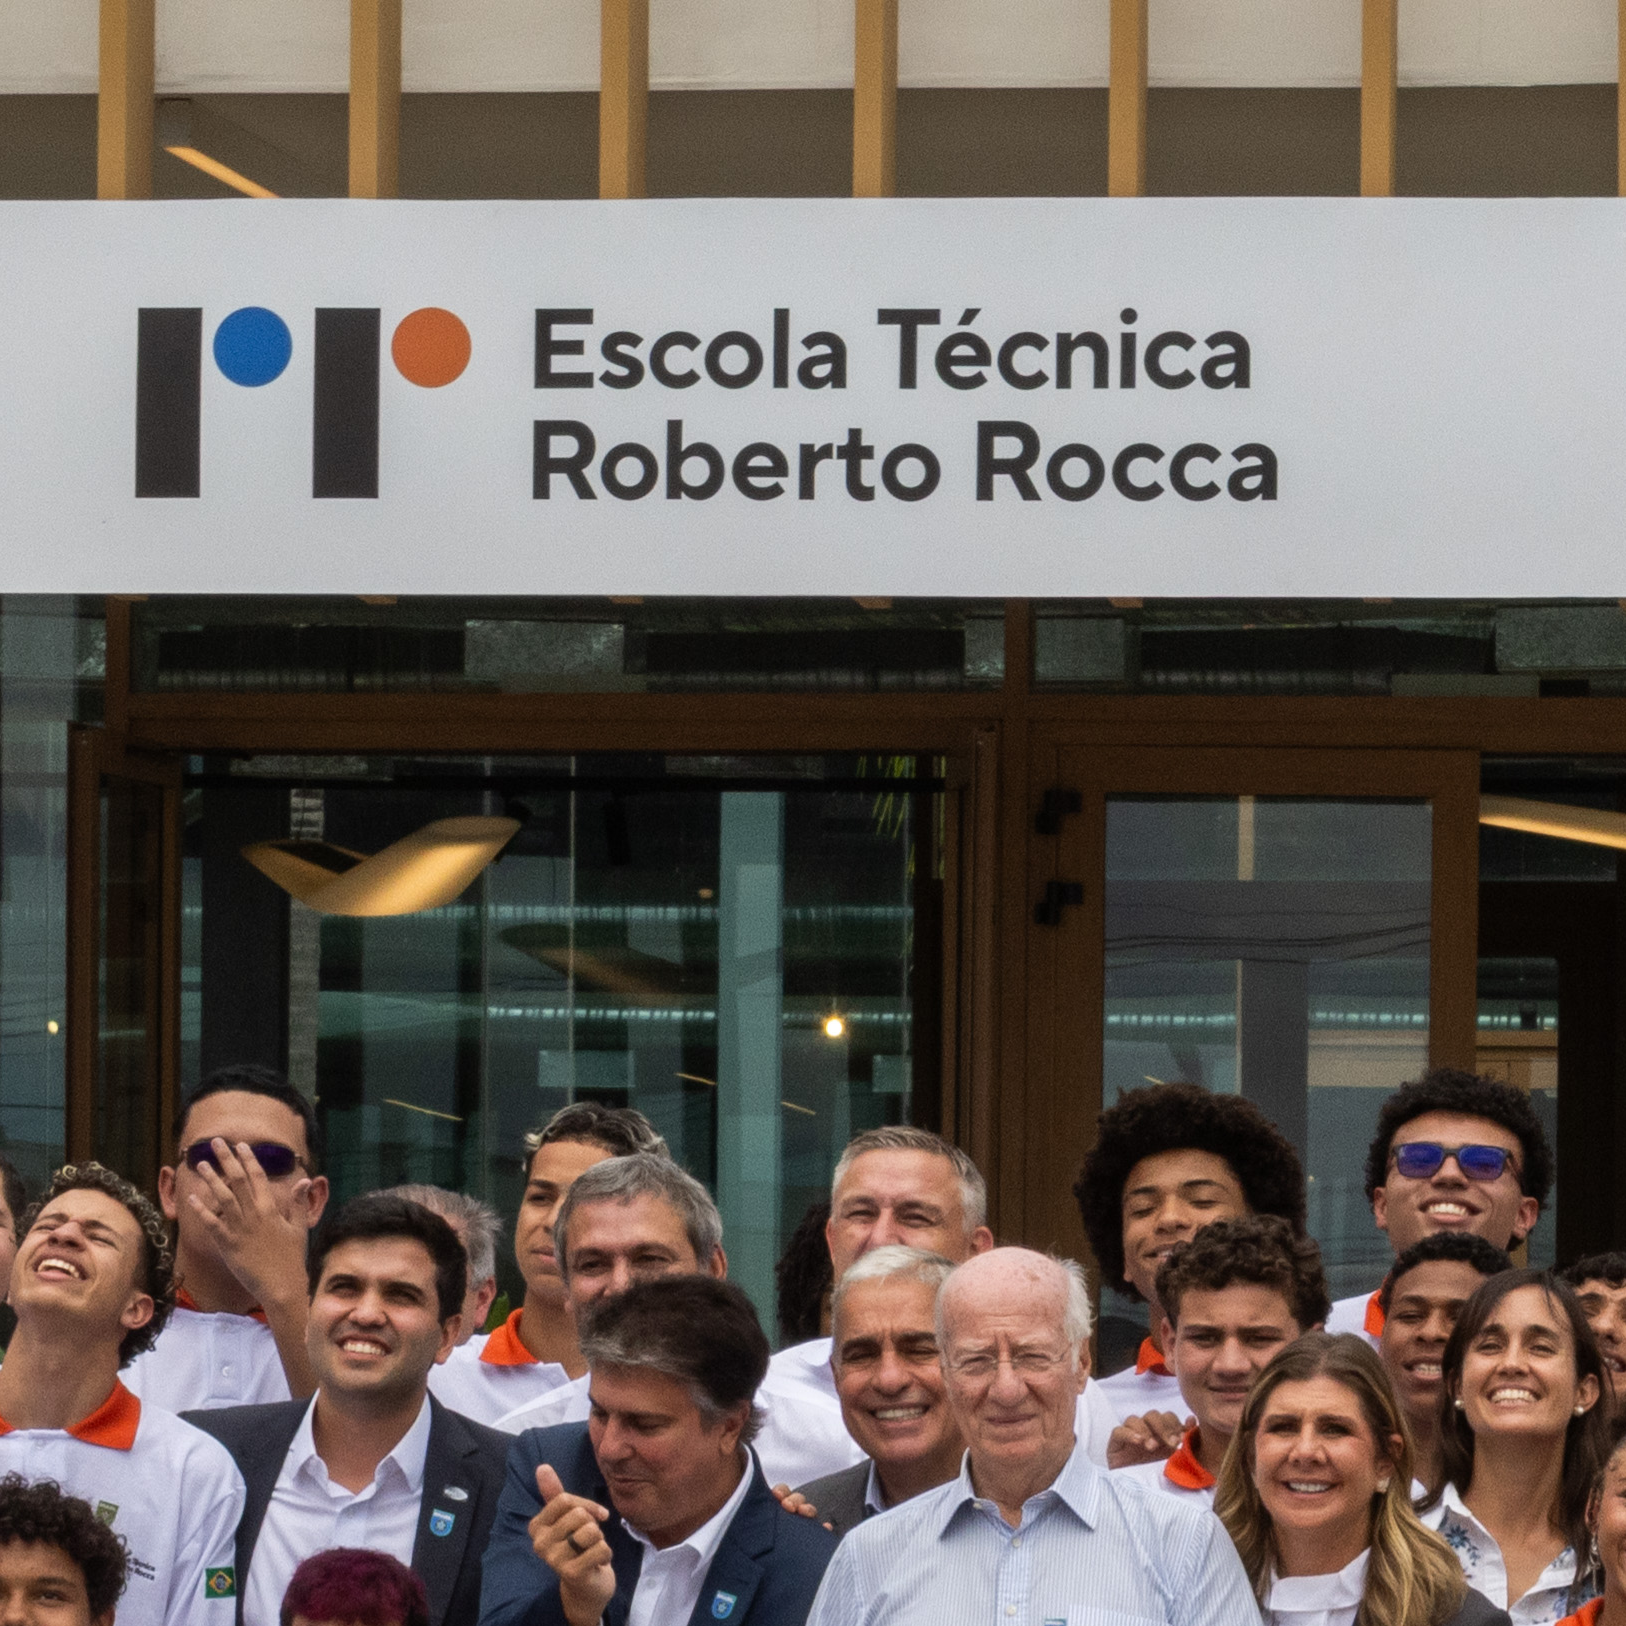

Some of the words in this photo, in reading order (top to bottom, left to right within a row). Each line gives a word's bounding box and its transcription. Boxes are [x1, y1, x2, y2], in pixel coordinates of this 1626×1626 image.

[534, 307, 847, 391] Escola
[877, 307, 1252, 391] Técnica
[531, 419, 942, 502] Roberto
[976, 419, 1278, 502] Rocca
